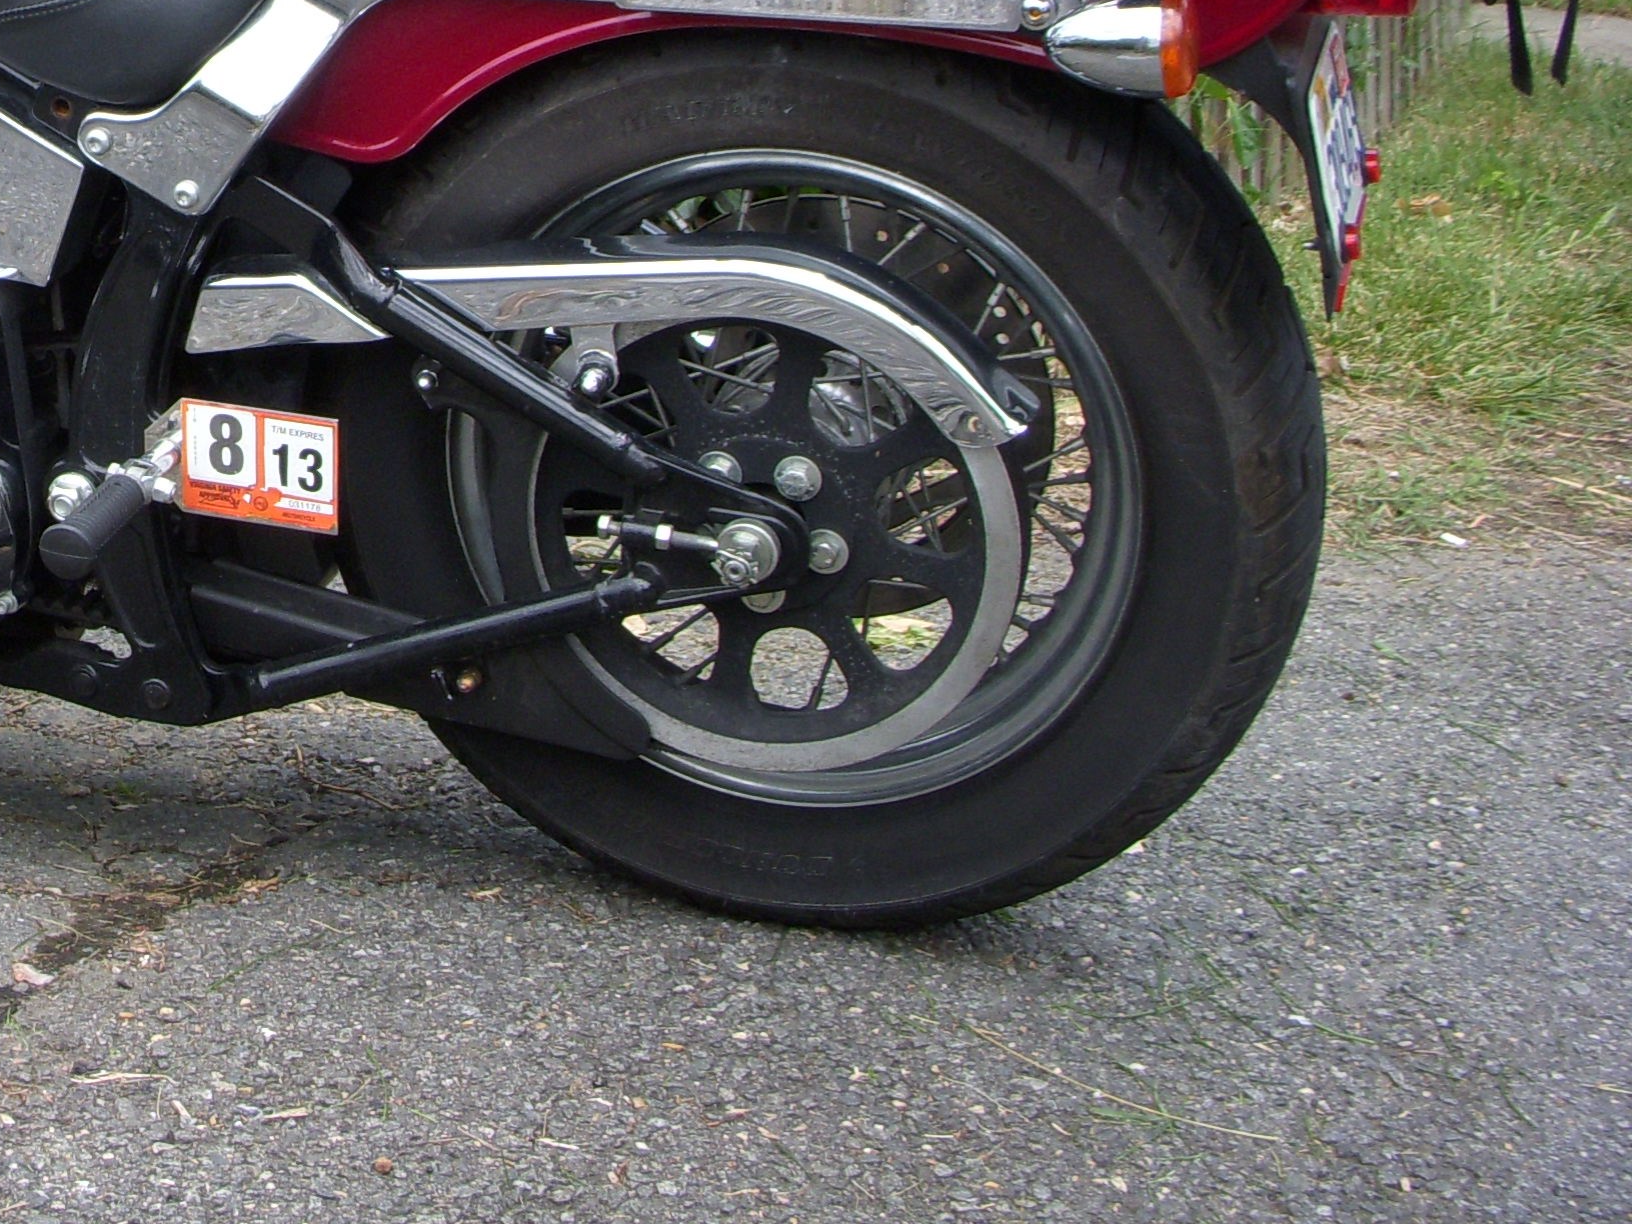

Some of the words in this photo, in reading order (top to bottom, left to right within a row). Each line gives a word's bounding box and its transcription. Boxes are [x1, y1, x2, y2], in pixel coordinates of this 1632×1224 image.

[209, 413, 244, 476] 8
[289, 428, 324, 442] EXPIRES
[272, 443, 323, 493] 13
